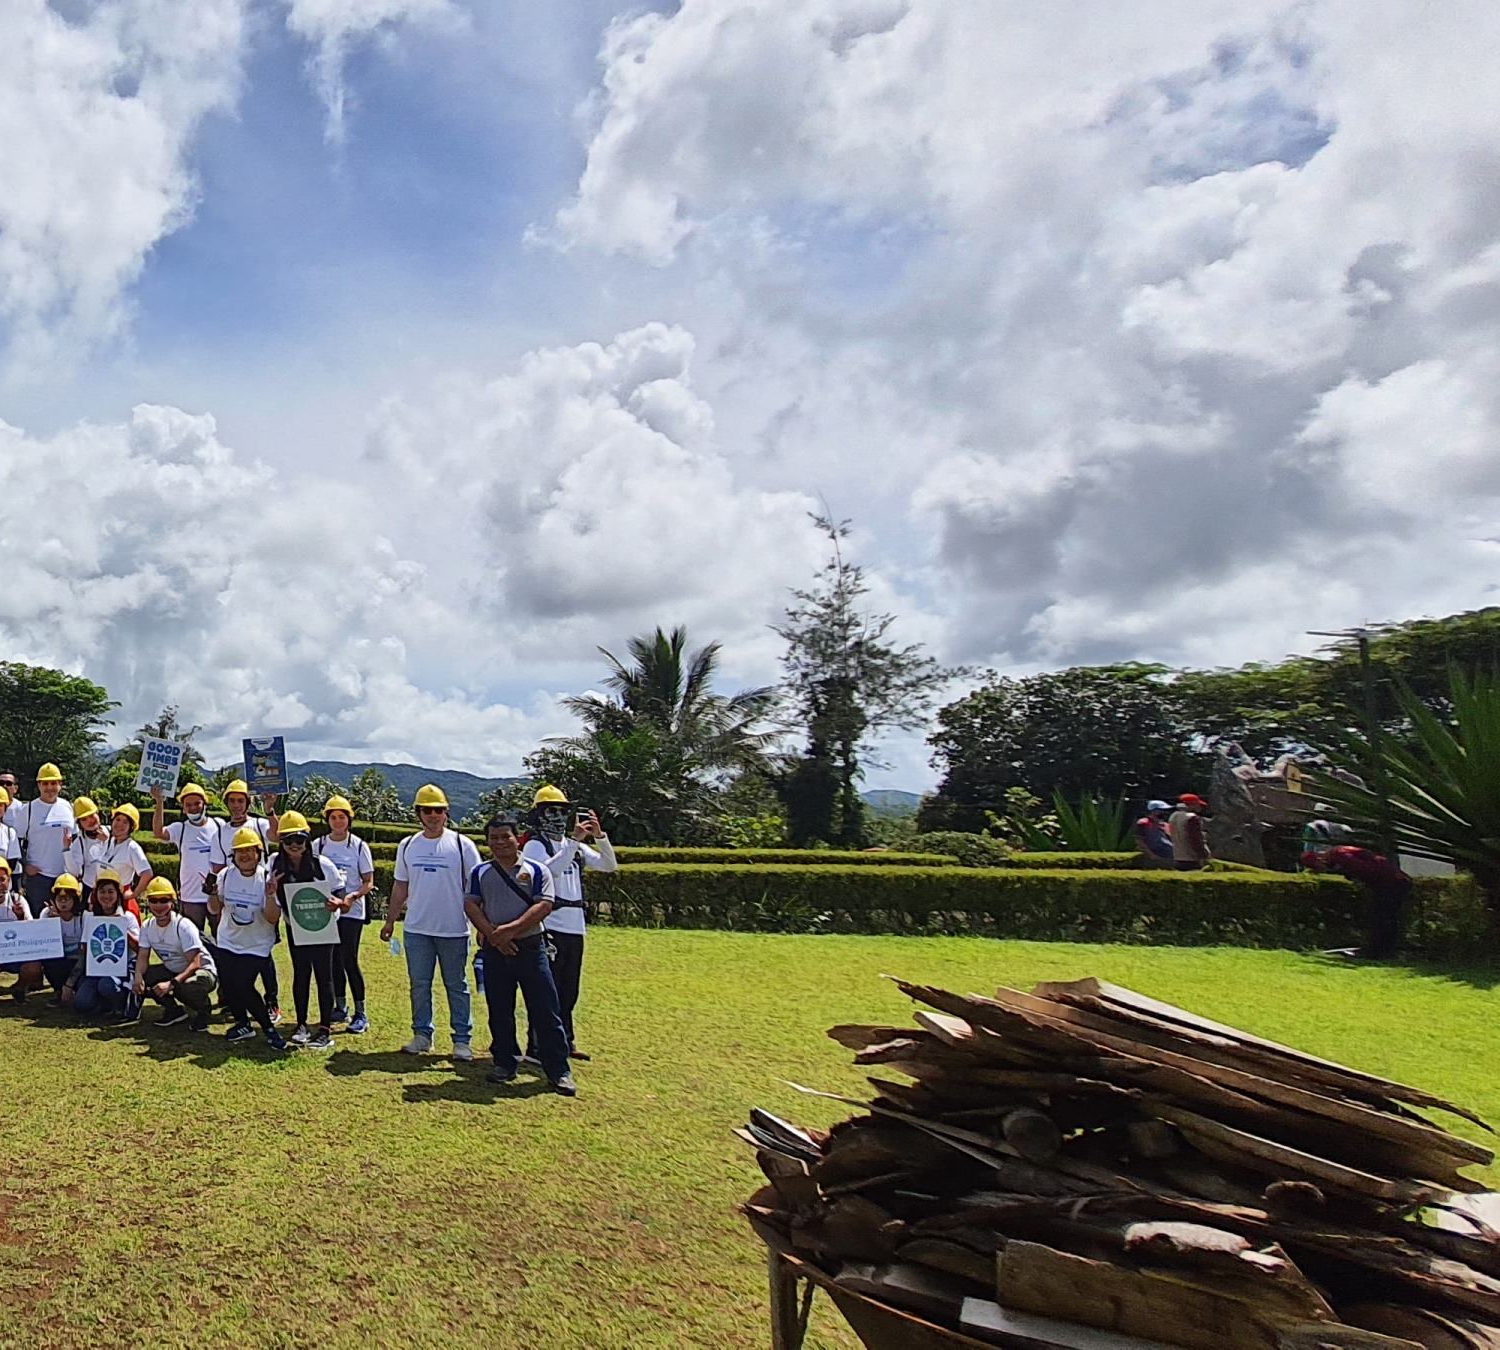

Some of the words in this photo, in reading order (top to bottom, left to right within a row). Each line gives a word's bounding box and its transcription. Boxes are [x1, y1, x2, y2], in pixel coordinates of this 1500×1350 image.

[148, 741, 180, 756] GOOD
[146, 751, 179, 767] TIMES
[142, 766, 176, 782] GOOD
